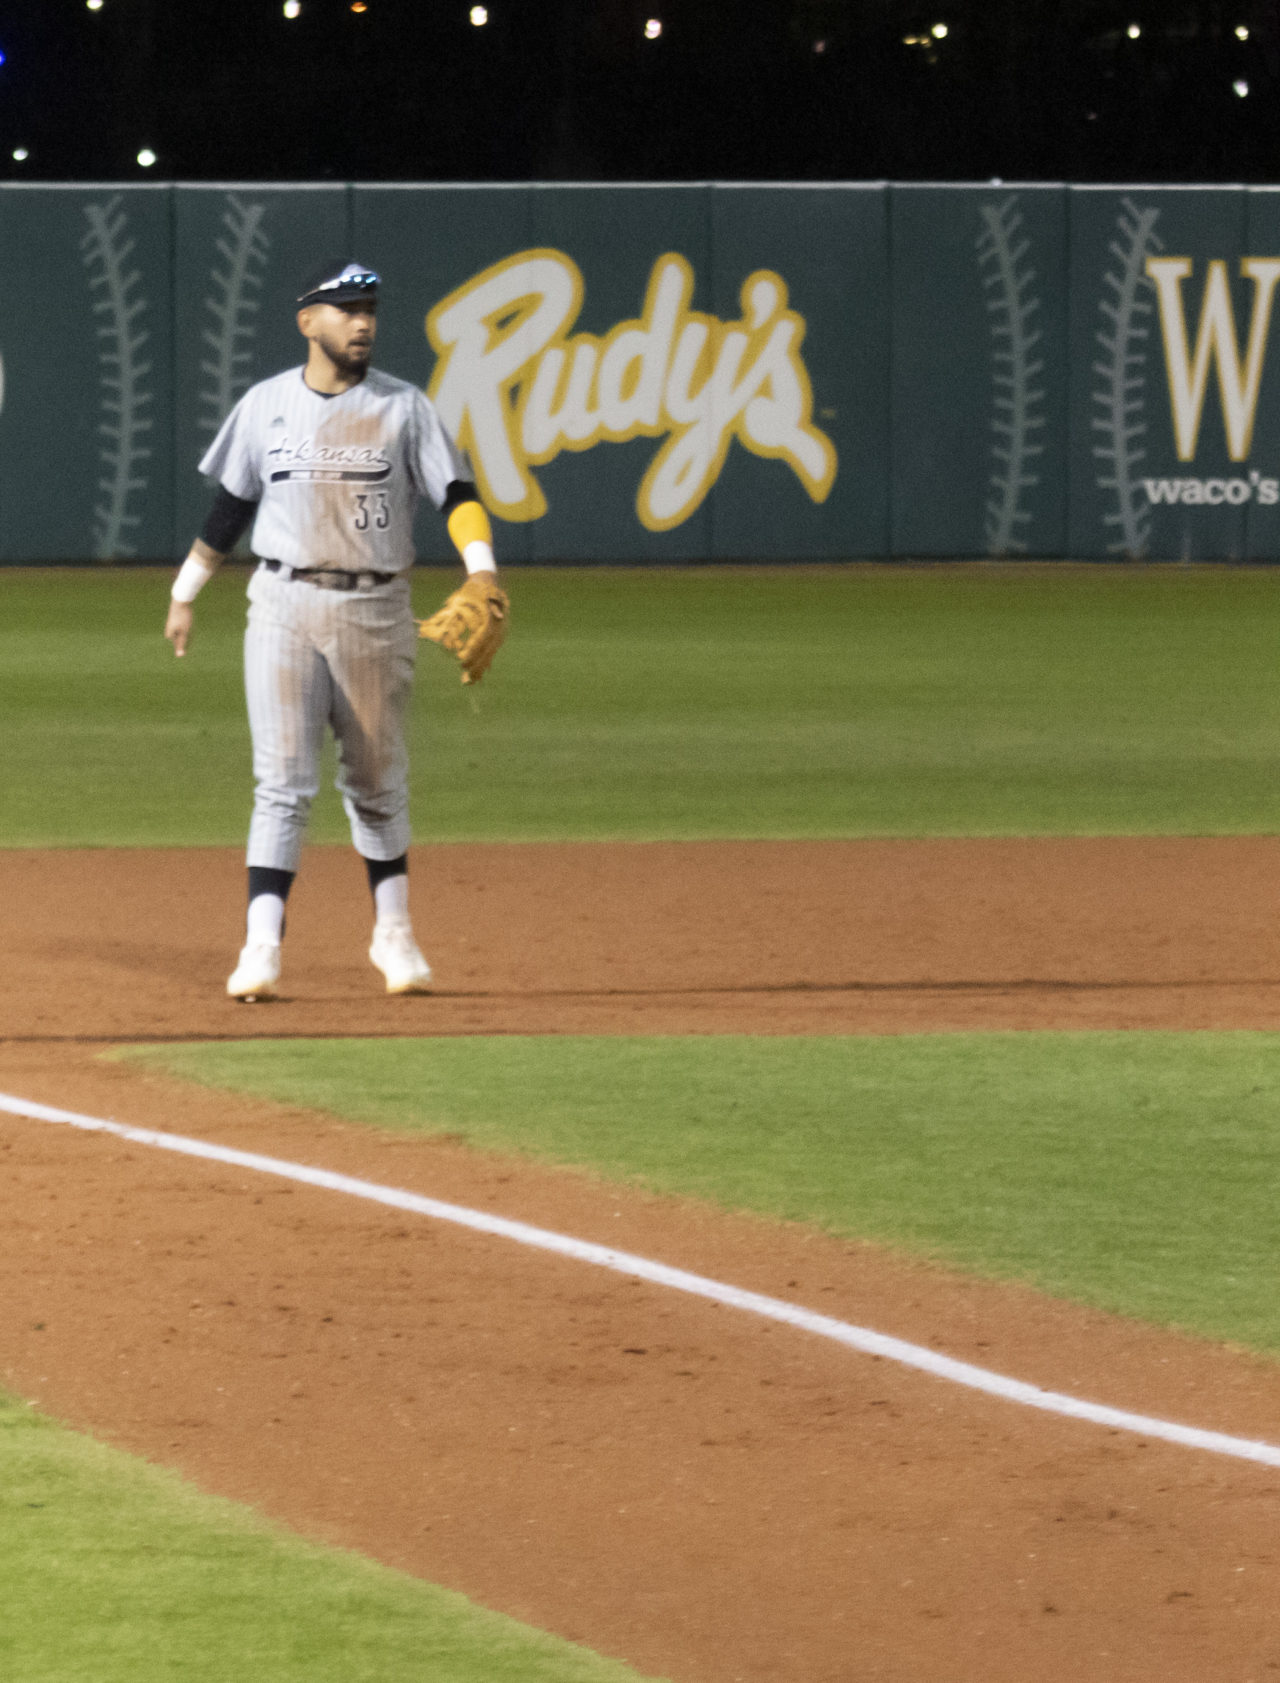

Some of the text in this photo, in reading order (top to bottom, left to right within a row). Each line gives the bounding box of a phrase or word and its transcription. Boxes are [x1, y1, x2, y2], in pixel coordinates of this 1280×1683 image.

[426, 248, 837, 531] Rudy's
[1143, 469, 1280, 505] waco's
[354, 492, 390, 531] 33
